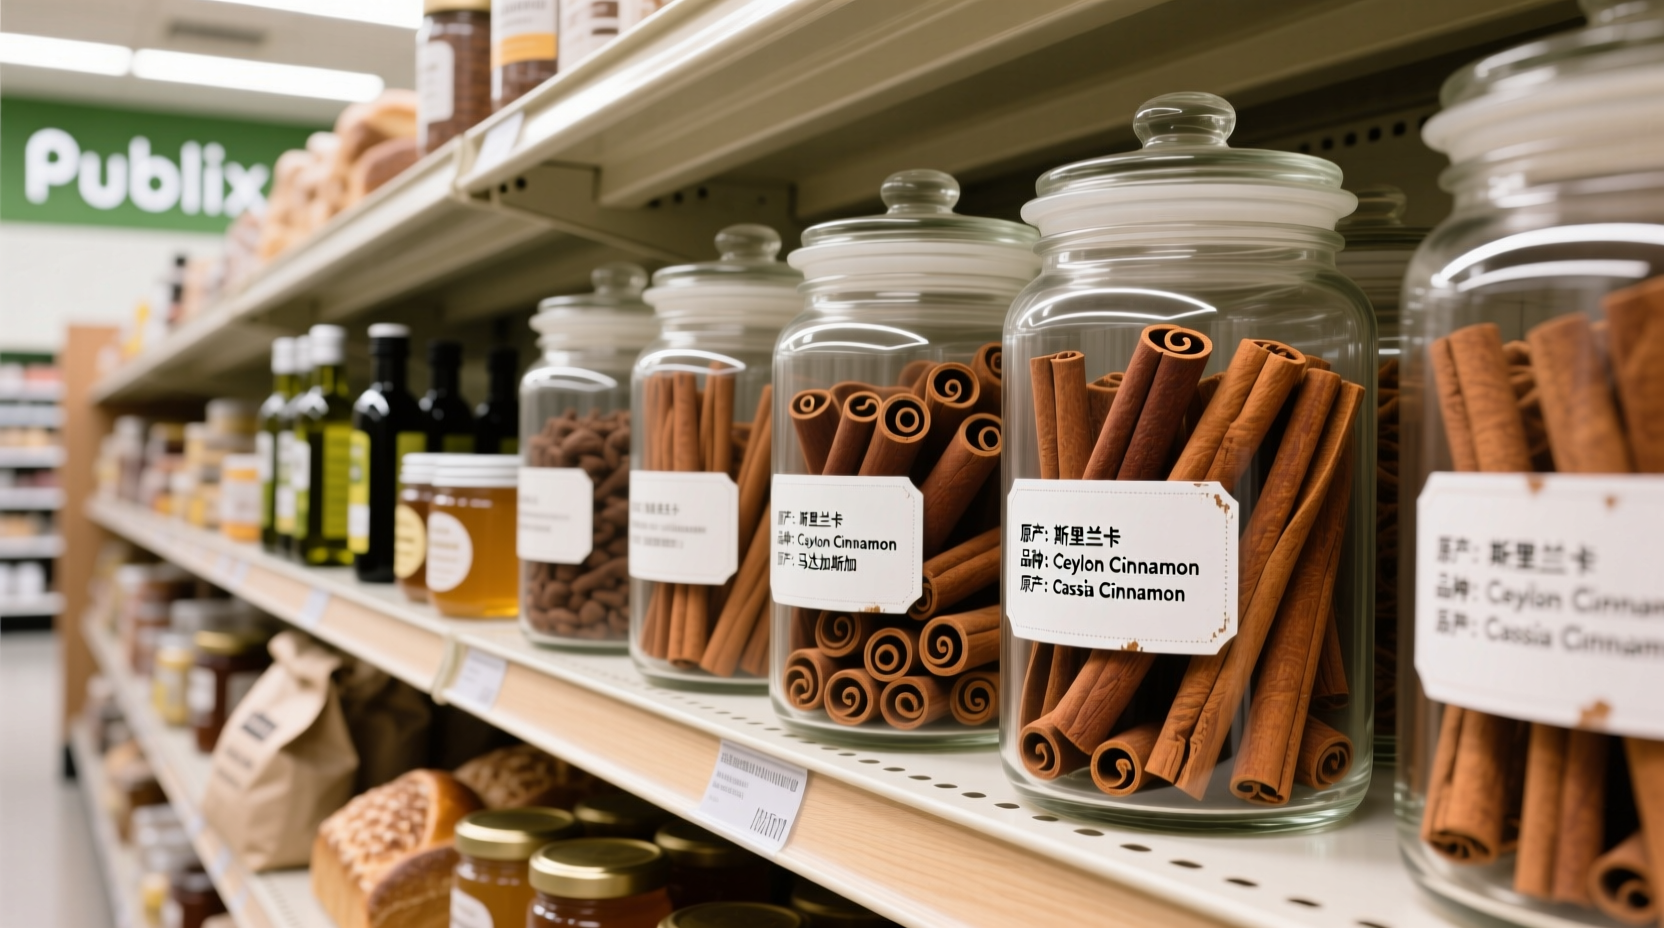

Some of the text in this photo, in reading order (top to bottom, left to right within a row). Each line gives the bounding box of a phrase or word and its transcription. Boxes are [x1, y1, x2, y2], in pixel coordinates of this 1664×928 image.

[25, 127, 270, 217] Publix
[833, 535, 897, 551] Cinnamon
[1054, 524, 1121, 548] 斯里兰卡
[1053, 553, 1104, 575] Ceylon
[1109, 556, 1200, 576] Cinnamon
[1488, 539, 1598, 576] 斯里兰卡
[1099, 582, 1185, 602] Cinnamon
[1486, 579, 1562, 613] Ceylon
[1484, 617, 1552, 648] Cassia
